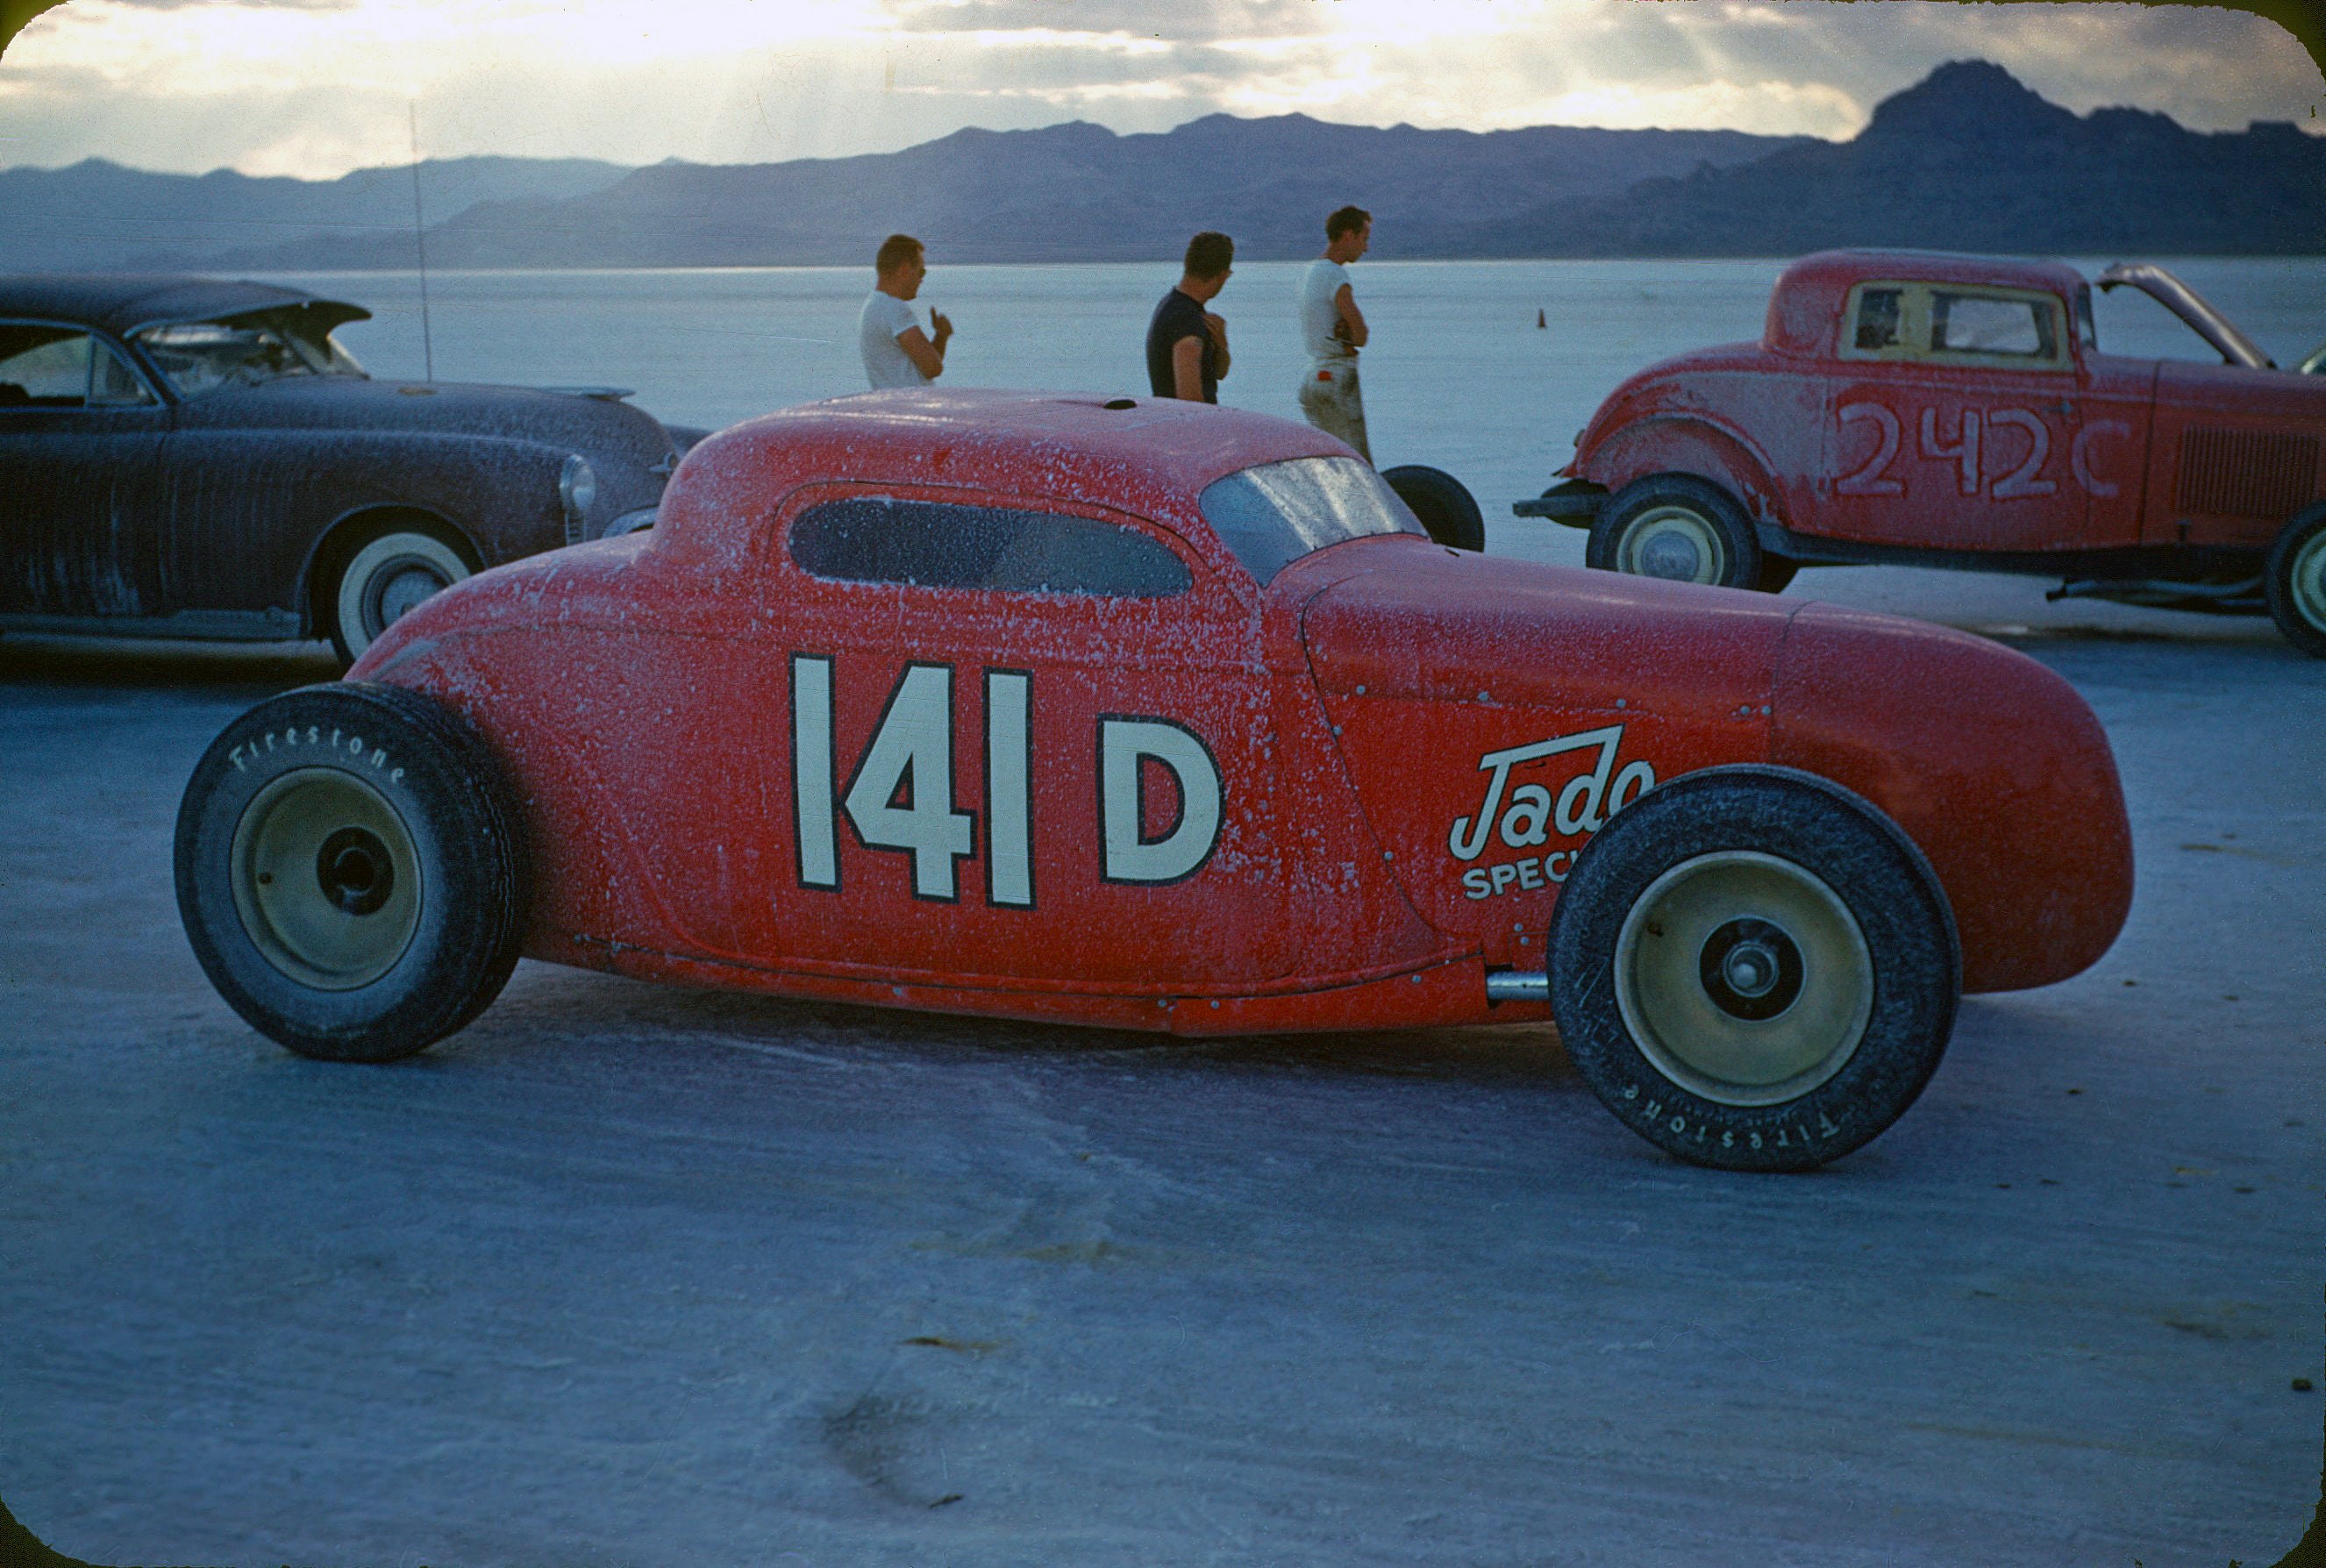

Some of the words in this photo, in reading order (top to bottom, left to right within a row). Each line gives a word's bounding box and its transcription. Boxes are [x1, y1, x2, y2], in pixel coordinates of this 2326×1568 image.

[1837, 403, 2130, 498] 242C
[228, 725, 404, 783] Firestone
[789, 651, 1038, 910] 141
[1096, 712, 1227, 887] D
[1448, 723, 1656, 861] Jado
[1623, 1085, 1840, 1149] Firestone
